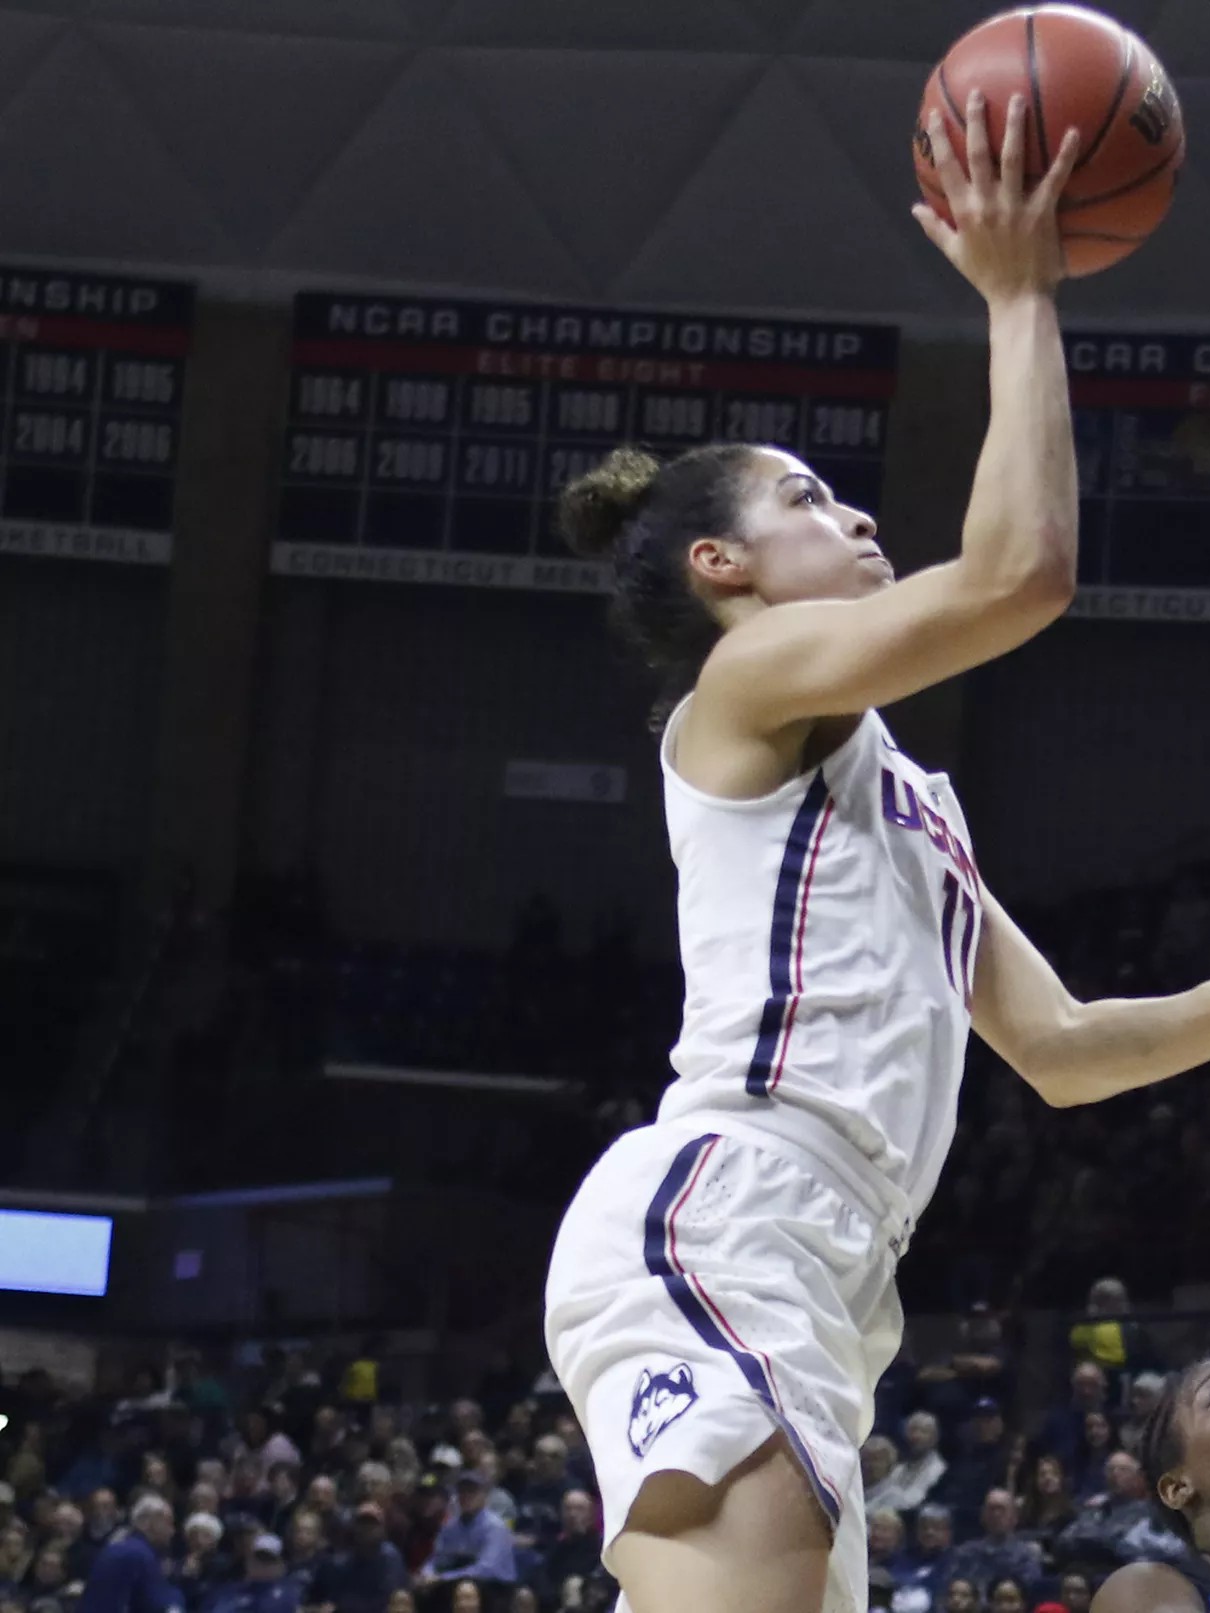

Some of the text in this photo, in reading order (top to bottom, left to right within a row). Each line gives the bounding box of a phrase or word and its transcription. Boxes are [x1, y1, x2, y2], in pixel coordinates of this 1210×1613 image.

[0, 275, 158, 314] NSHIP
[328, 303, 864, 361] NCAA CHAMPIONSHIP
[1070, 341, 1167, 373] CAA
